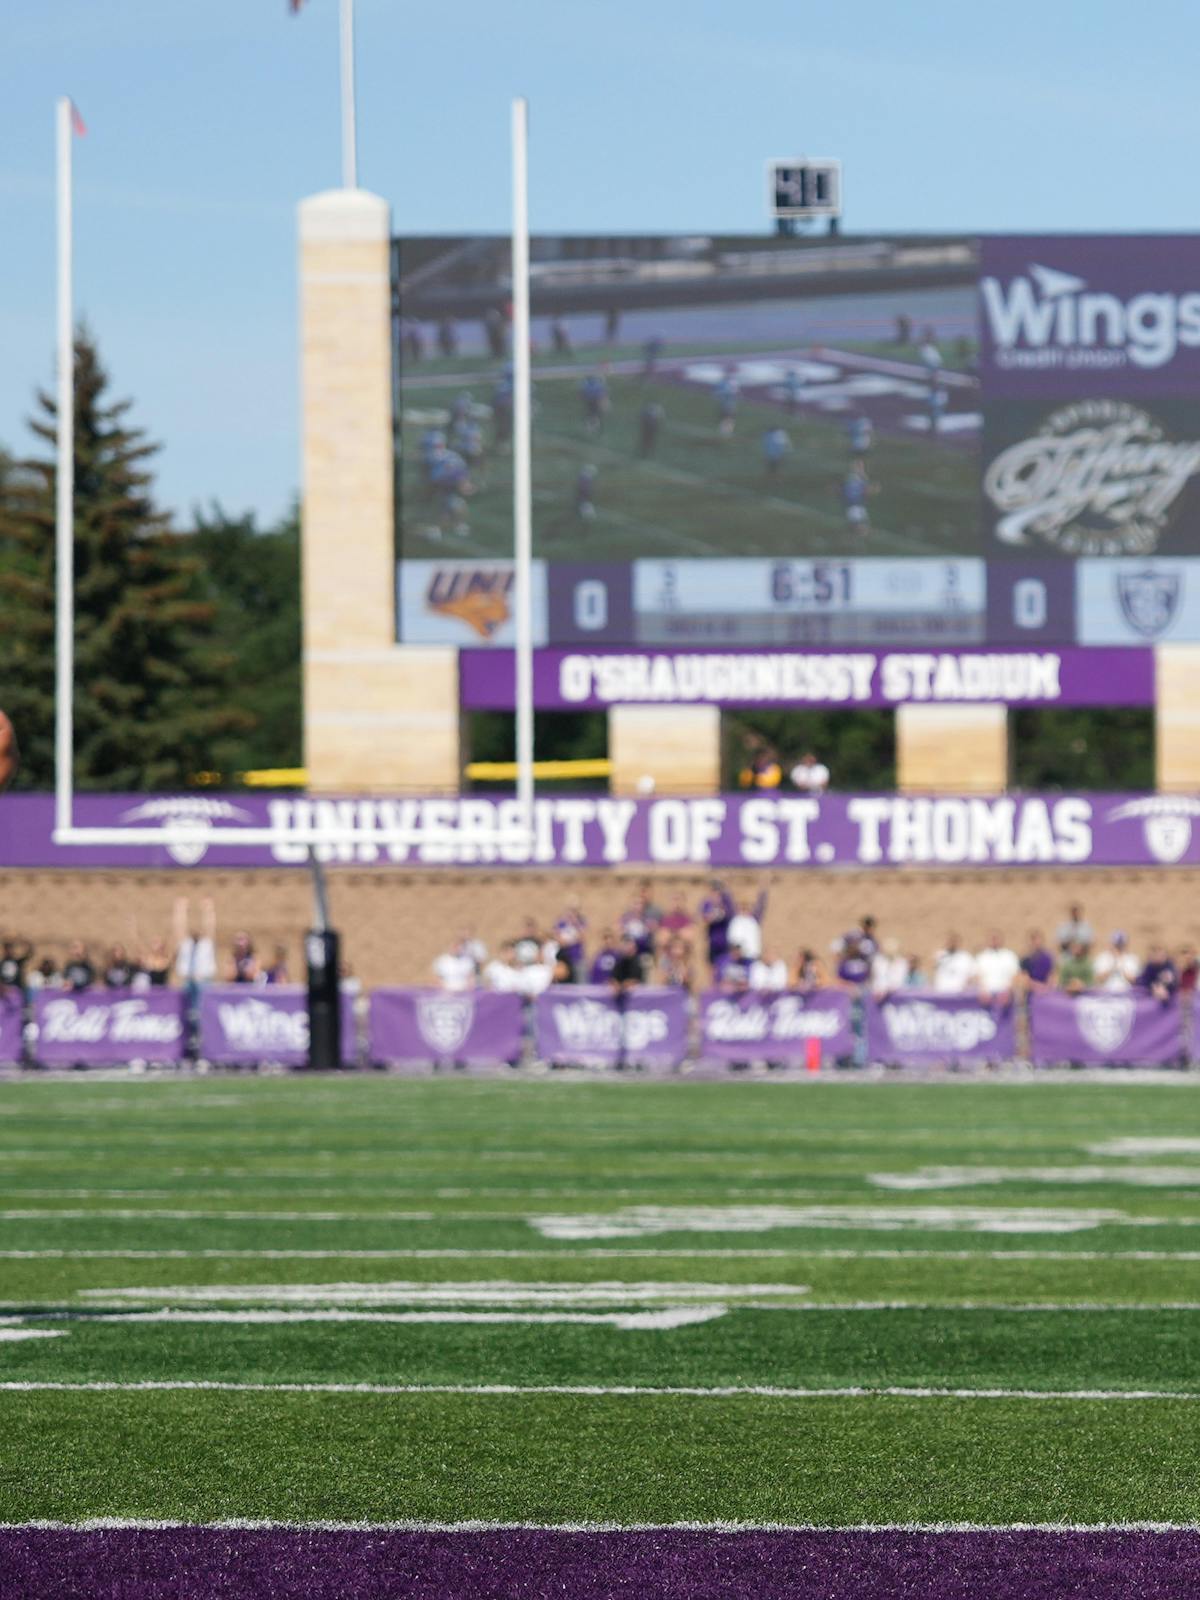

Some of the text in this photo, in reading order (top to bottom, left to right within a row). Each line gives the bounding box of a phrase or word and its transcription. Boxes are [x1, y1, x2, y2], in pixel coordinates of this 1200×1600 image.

[575, 580, 607, 631] 0
[771, 565, 850, 602] 6:51
[1013, 578, 1047, 629] 0
[559, 655, 1061, 701] O'SHAUGHNESSY STADIUM
[268, 800, 637, 863] UNIVERSITY
[648, 800, 726, 862] OF
[739, 799, 835, 862] ST.
[847, 799, 1093, 863] THOMAS
[219, 998, 310, 1050] Wing
[553, 999, 668, 1050] Wings
[882, 1001, 997, 1051] Wings
